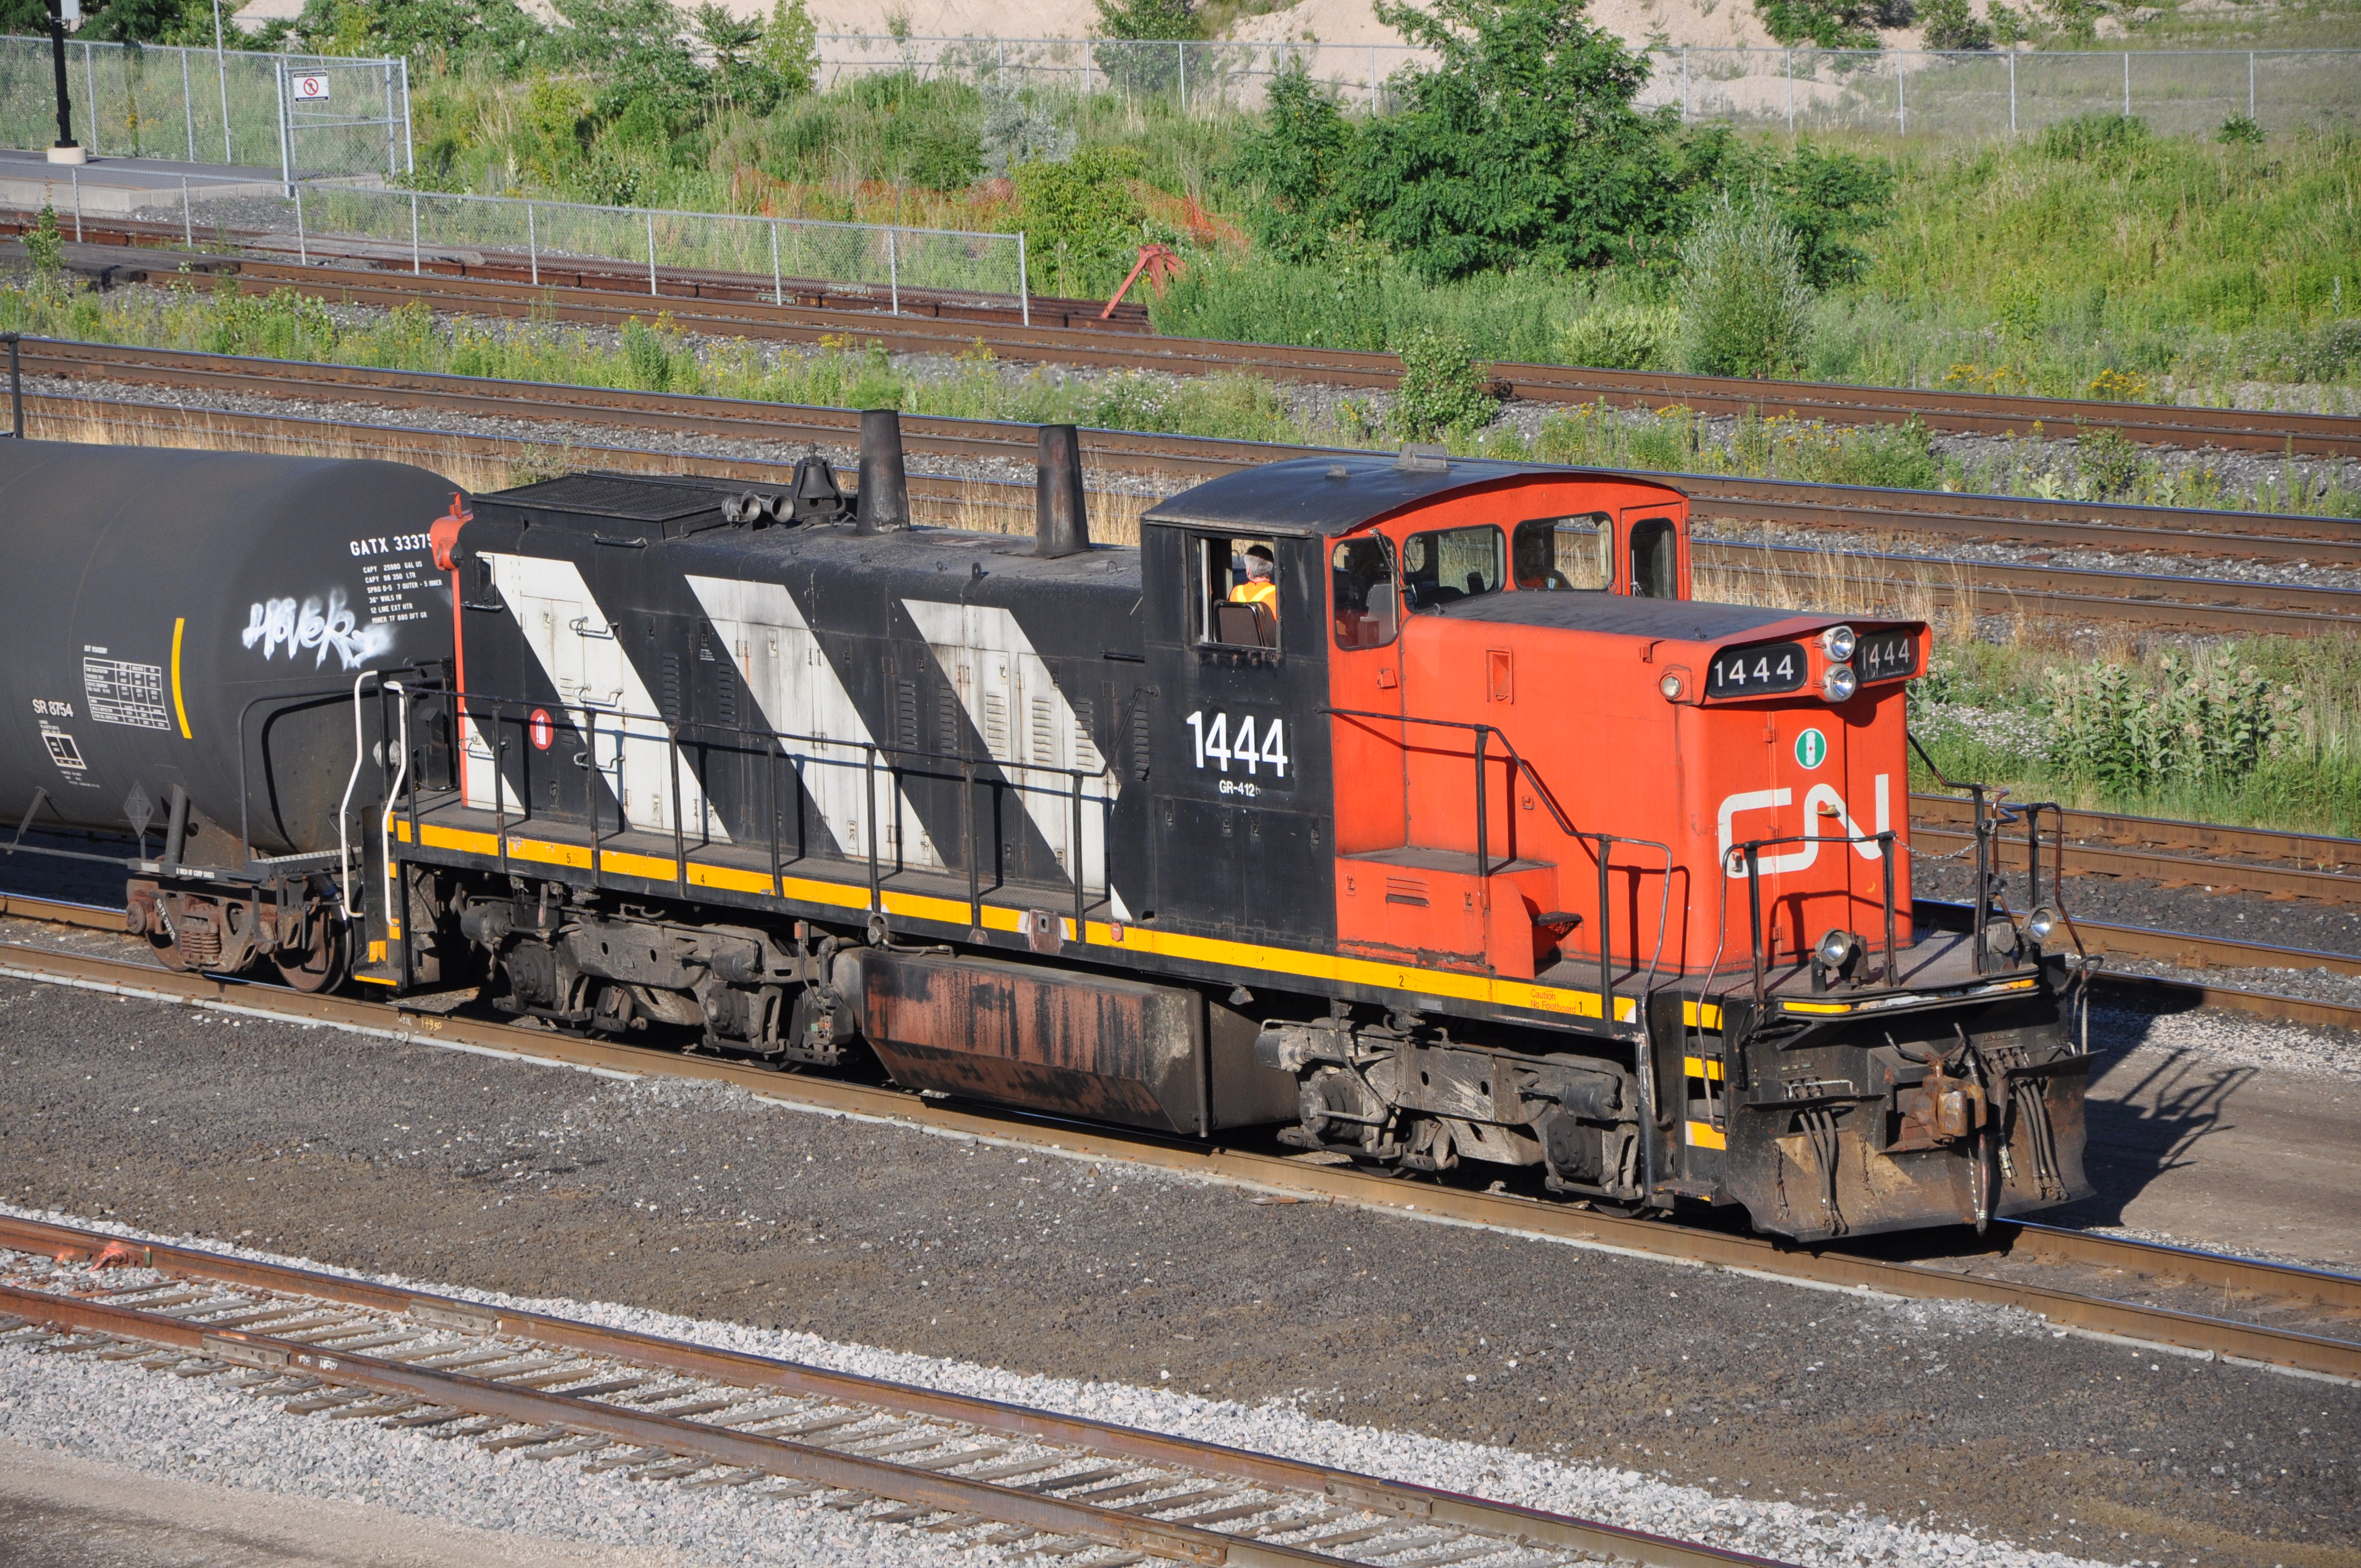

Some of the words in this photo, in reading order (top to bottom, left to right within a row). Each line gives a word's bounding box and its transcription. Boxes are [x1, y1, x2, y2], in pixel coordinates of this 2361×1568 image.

[350, 537, 389, 556] GATX
[402, 581, 418, 590] OUTER
[380, 595, 394, 603] WHLS
[378, 605, 390, 613] LINE
[391, 604, 401, 612] EXT
[1860, 638, 1910, 671] 1444
[1713, 655, 1794, 687] 1444
[32, 699, 48, 715] SR
[48, 701, 74, 717] 8754
[1187, 711, 1288, 777] 1444
[1718, 774, 1890, 879] CN
[567, 853, 571, 864] 5
[700, 874, 705, 884] 4
[1399, 975, 1404, 987] 2
[1531, 989, 1555, 1000] Caution
[1531, 999, 1539, 1009] No
[1542, 1001, 1576, 1014] Footboard
[1579, 1001, 1582, 1013] 1
[319, 1358, 338, 1370] NEW
